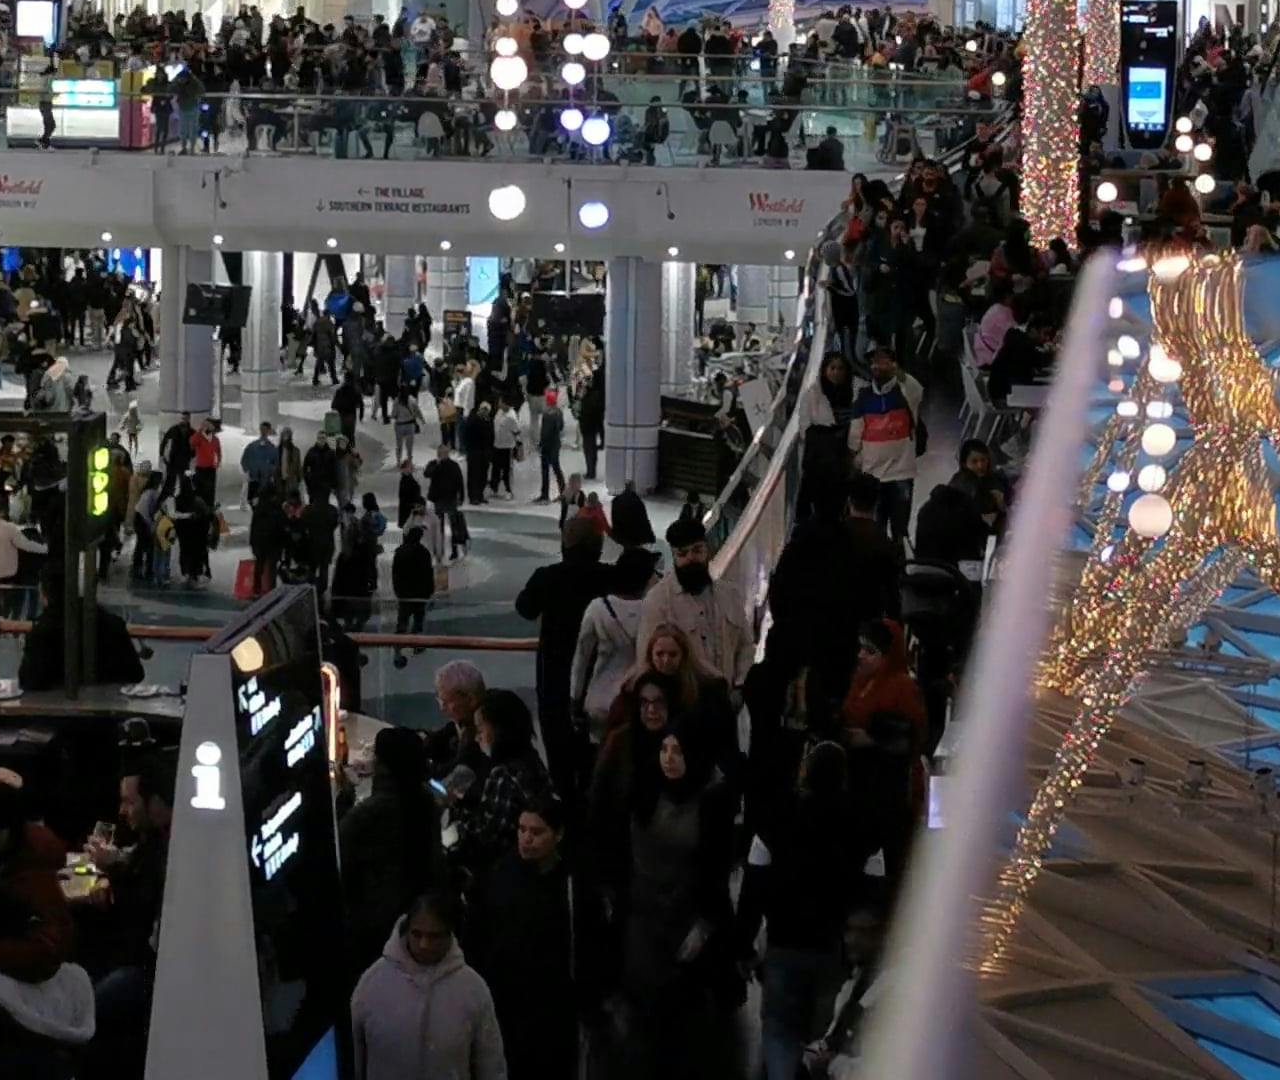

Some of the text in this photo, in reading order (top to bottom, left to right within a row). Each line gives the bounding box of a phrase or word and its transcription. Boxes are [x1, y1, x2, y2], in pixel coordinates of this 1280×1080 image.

[375, 201, 411, 214] TERRACE
[412, 202, 471, 215] RESTAURANTS
[749, 192, 806, 213] Westfield
